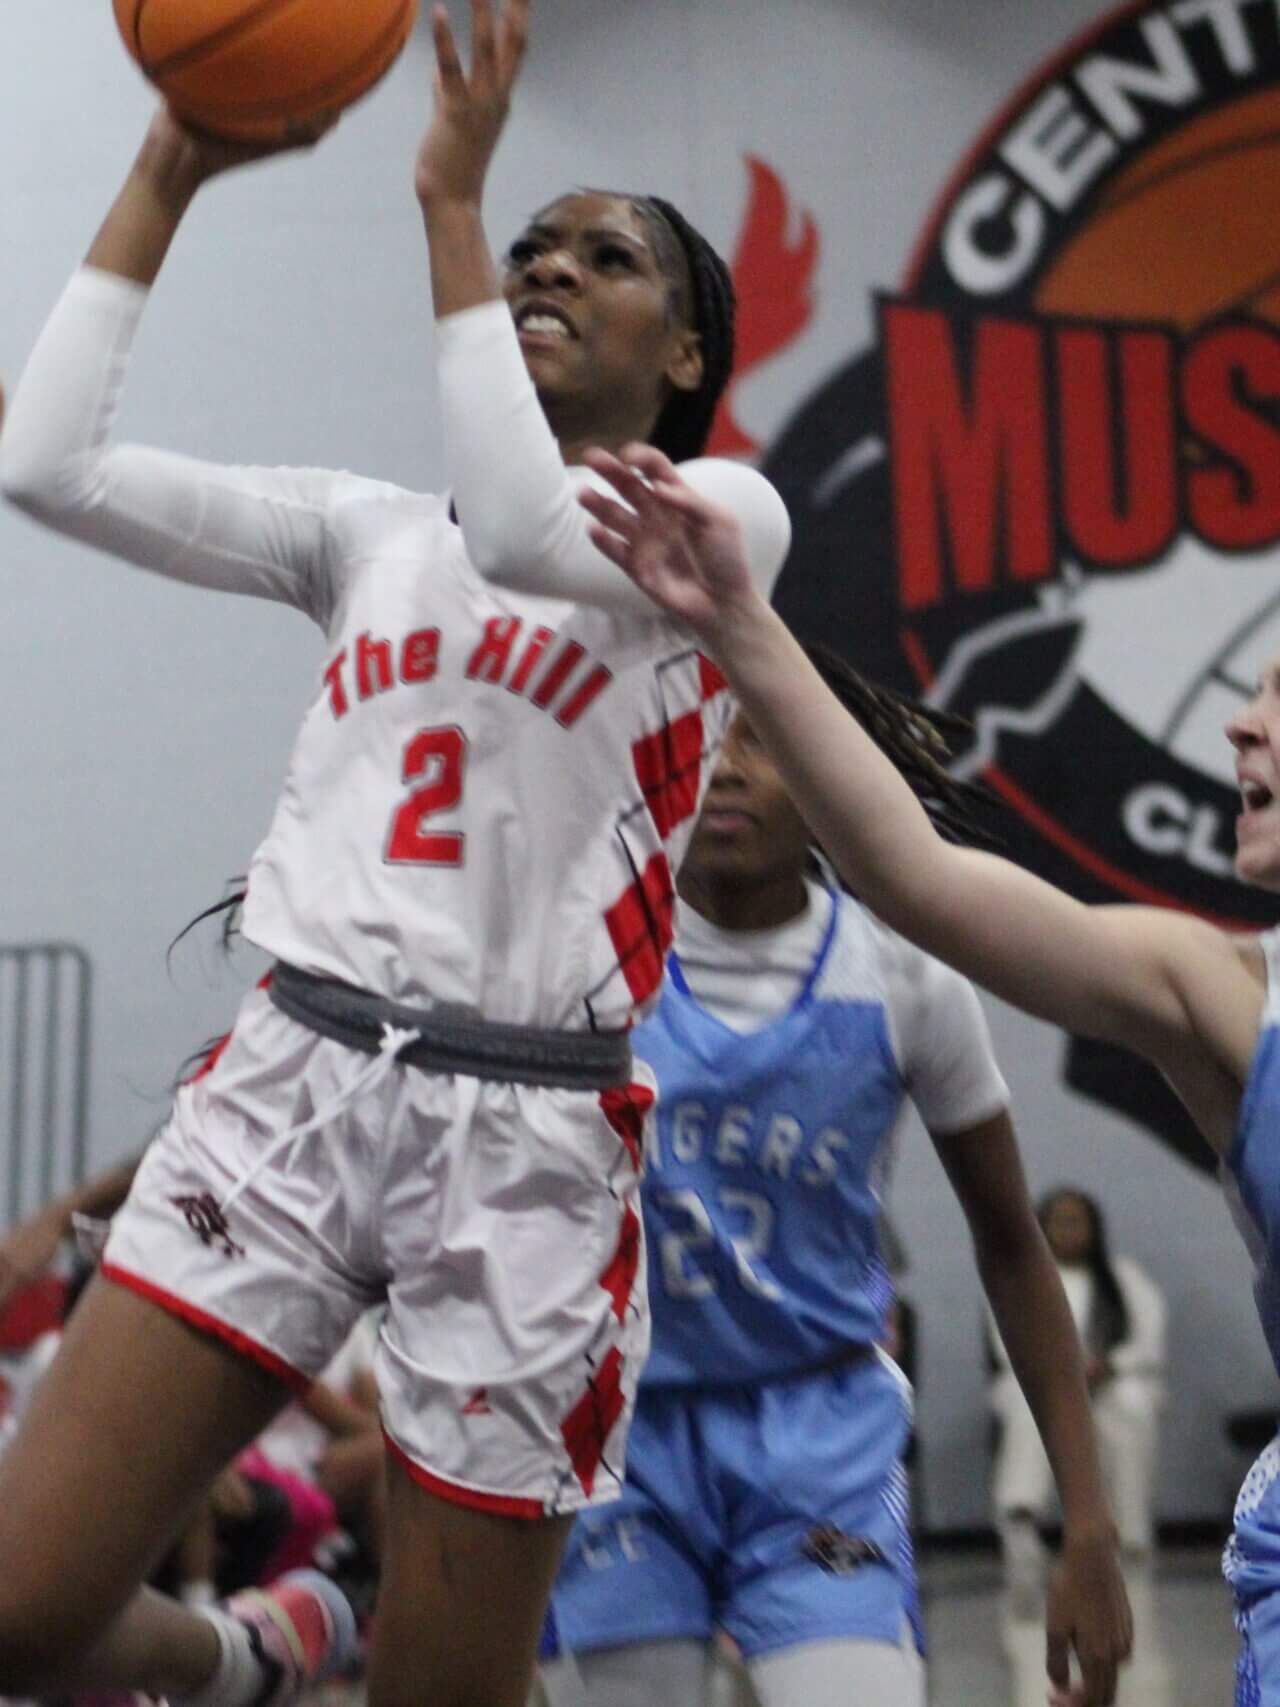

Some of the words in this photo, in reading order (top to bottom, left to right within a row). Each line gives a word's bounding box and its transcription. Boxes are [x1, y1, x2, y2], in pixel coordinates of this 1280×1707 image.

[944, 0, 1280, 295] CENT
[885, 304, 1280, 610] MUS
[324, 626, 442, 721] The
[464, 616, 614, 731] Hill
[382, 722, 469, 870] 2
[646, 1101, 850, 1187] IGERS
